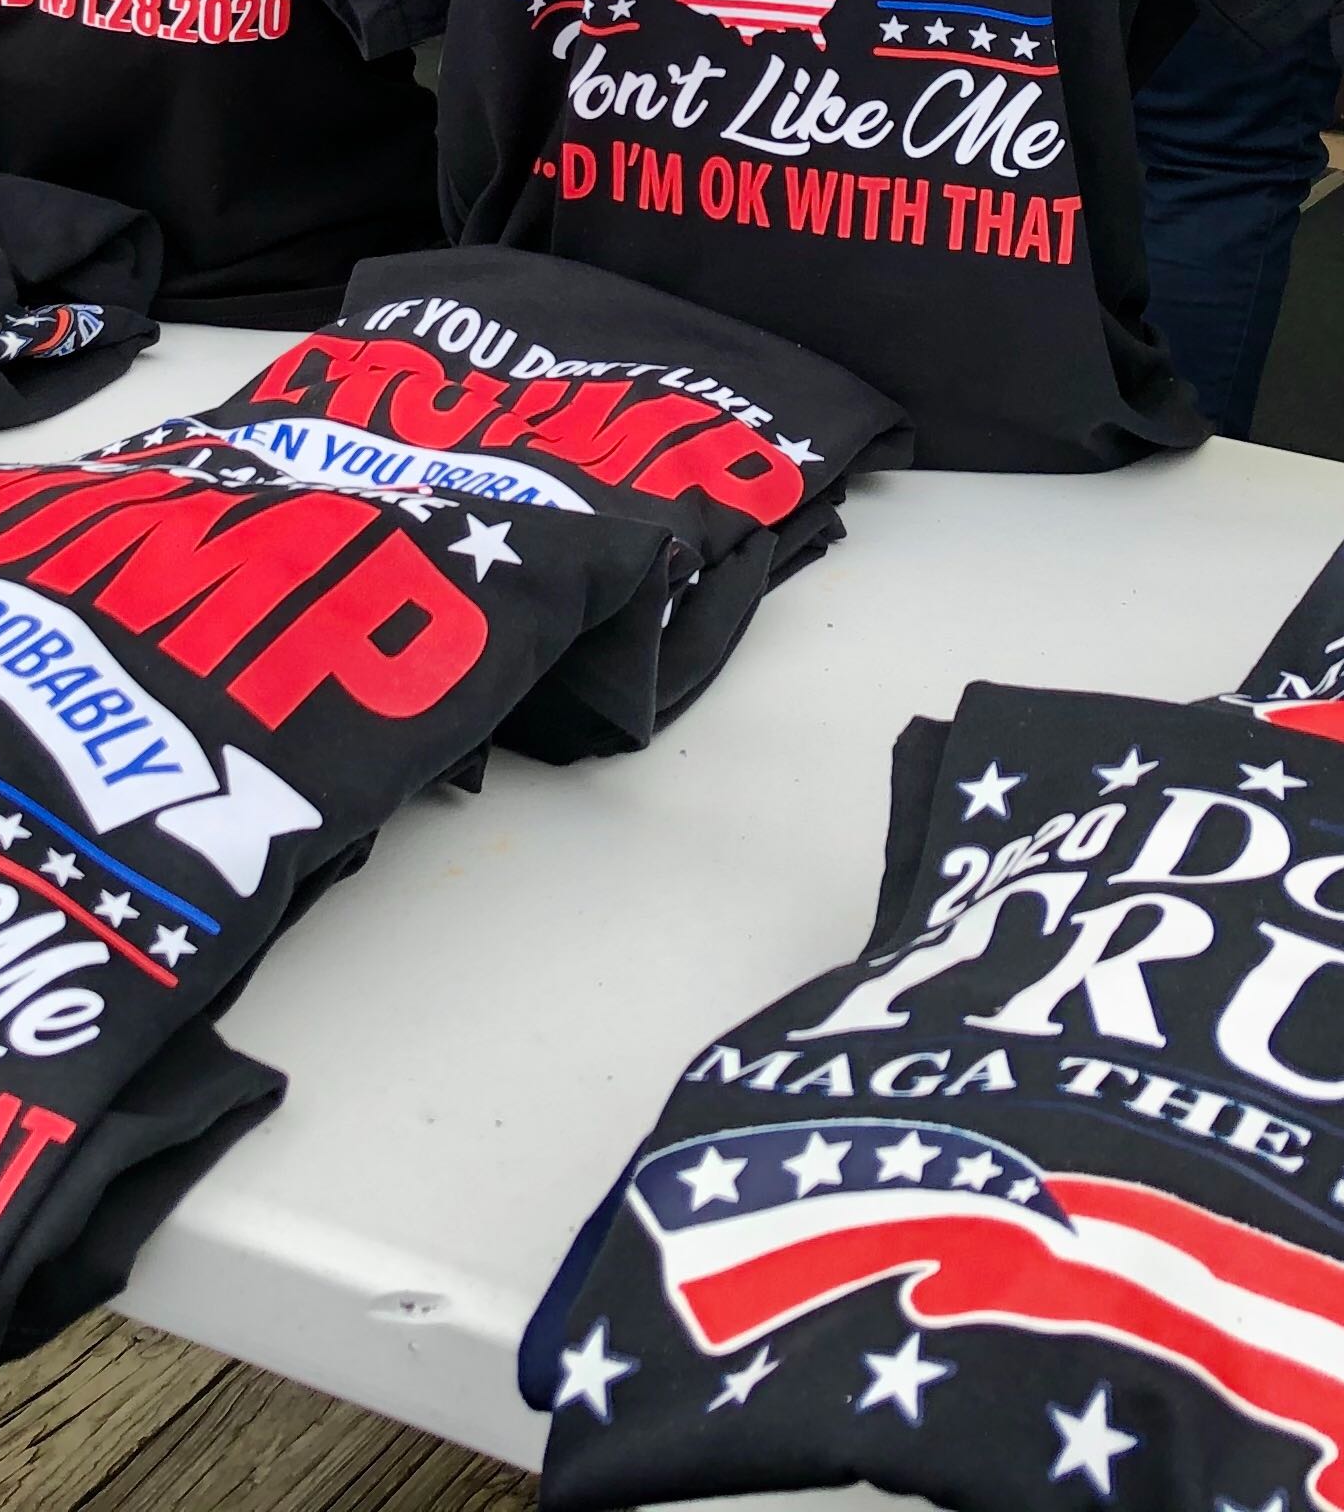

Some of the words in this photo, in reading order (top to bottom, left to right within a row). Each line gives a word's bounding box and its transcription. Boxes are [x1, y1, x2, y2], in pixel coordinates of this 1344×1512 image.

[719, 53, 895, 158] Like
[903, 68, 1068, 179] Me
[699, 155, 771, 229] OK
[784, 169, 929, 246] WITH
[943, 184, 1083, 266] THAT
[364, 297, 425, 330] IF
[414, 297, 519, 374] YOU
[657, 366, 777, 430] LIKE
[319, 433, 416, 487] YOU
[927, 800, 1128, 930] 2020
[685, 1041, 1020, 1099] MAGA
[1057, 1055, 1311, 1174] THE
